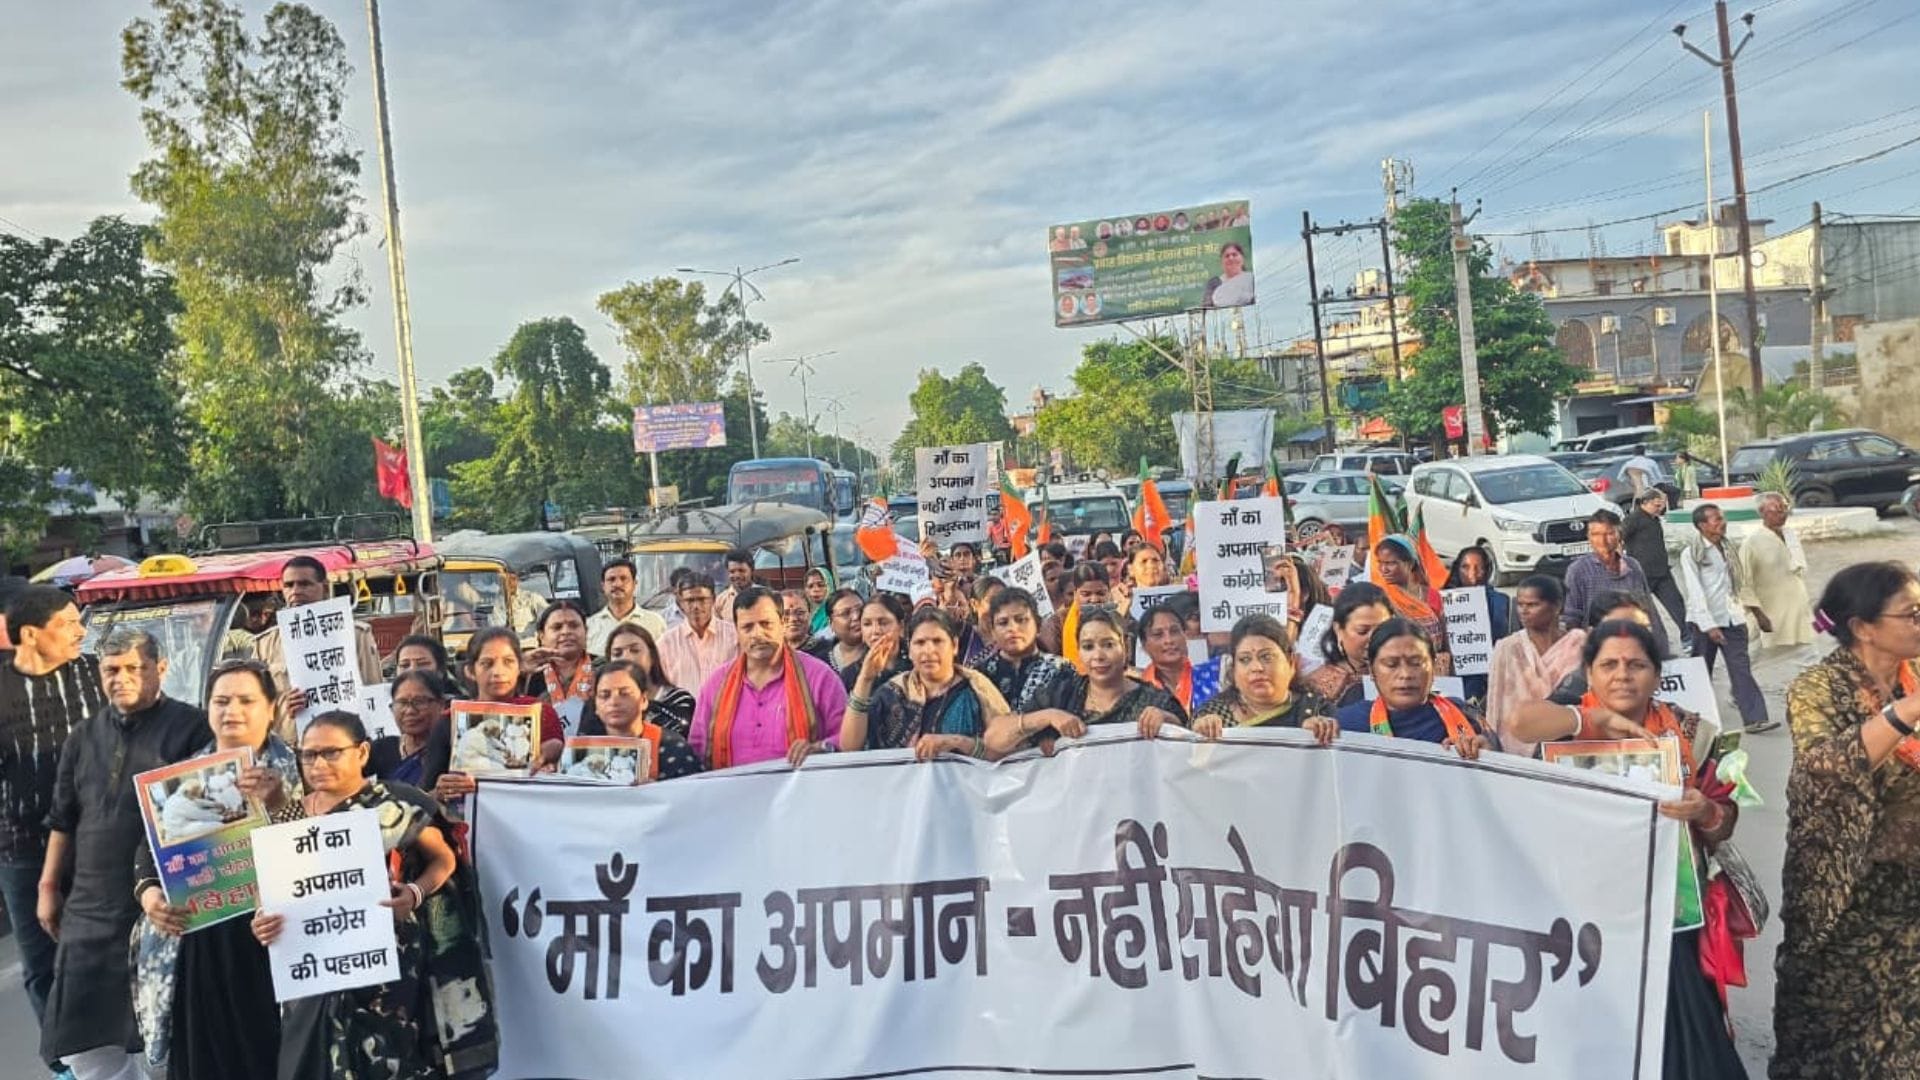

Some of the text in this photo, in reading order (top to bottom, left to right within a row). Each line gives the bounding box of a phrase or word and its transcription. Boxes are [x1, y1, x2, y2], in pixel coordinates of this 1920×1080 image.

[934, 449, 970, 465] माँ का
[929, 476, 975, 488] अपमान
[921, 496, 947, 513] नहीं
[1220, 507, 1262, 526] माँ का
[1211, 599, 1232, 620] की
[294, 826, 352, 854] माँ का
[292, 868, 365, 898] अपमान
[646, 892, 742, 997] का
[756, 876, 991, 994] अपमान
[1049, 818, 1173, 989] नहीं
[303, 906, 367, 937] कांग्रेस
[289, 948, 388, 981] की पहचान
